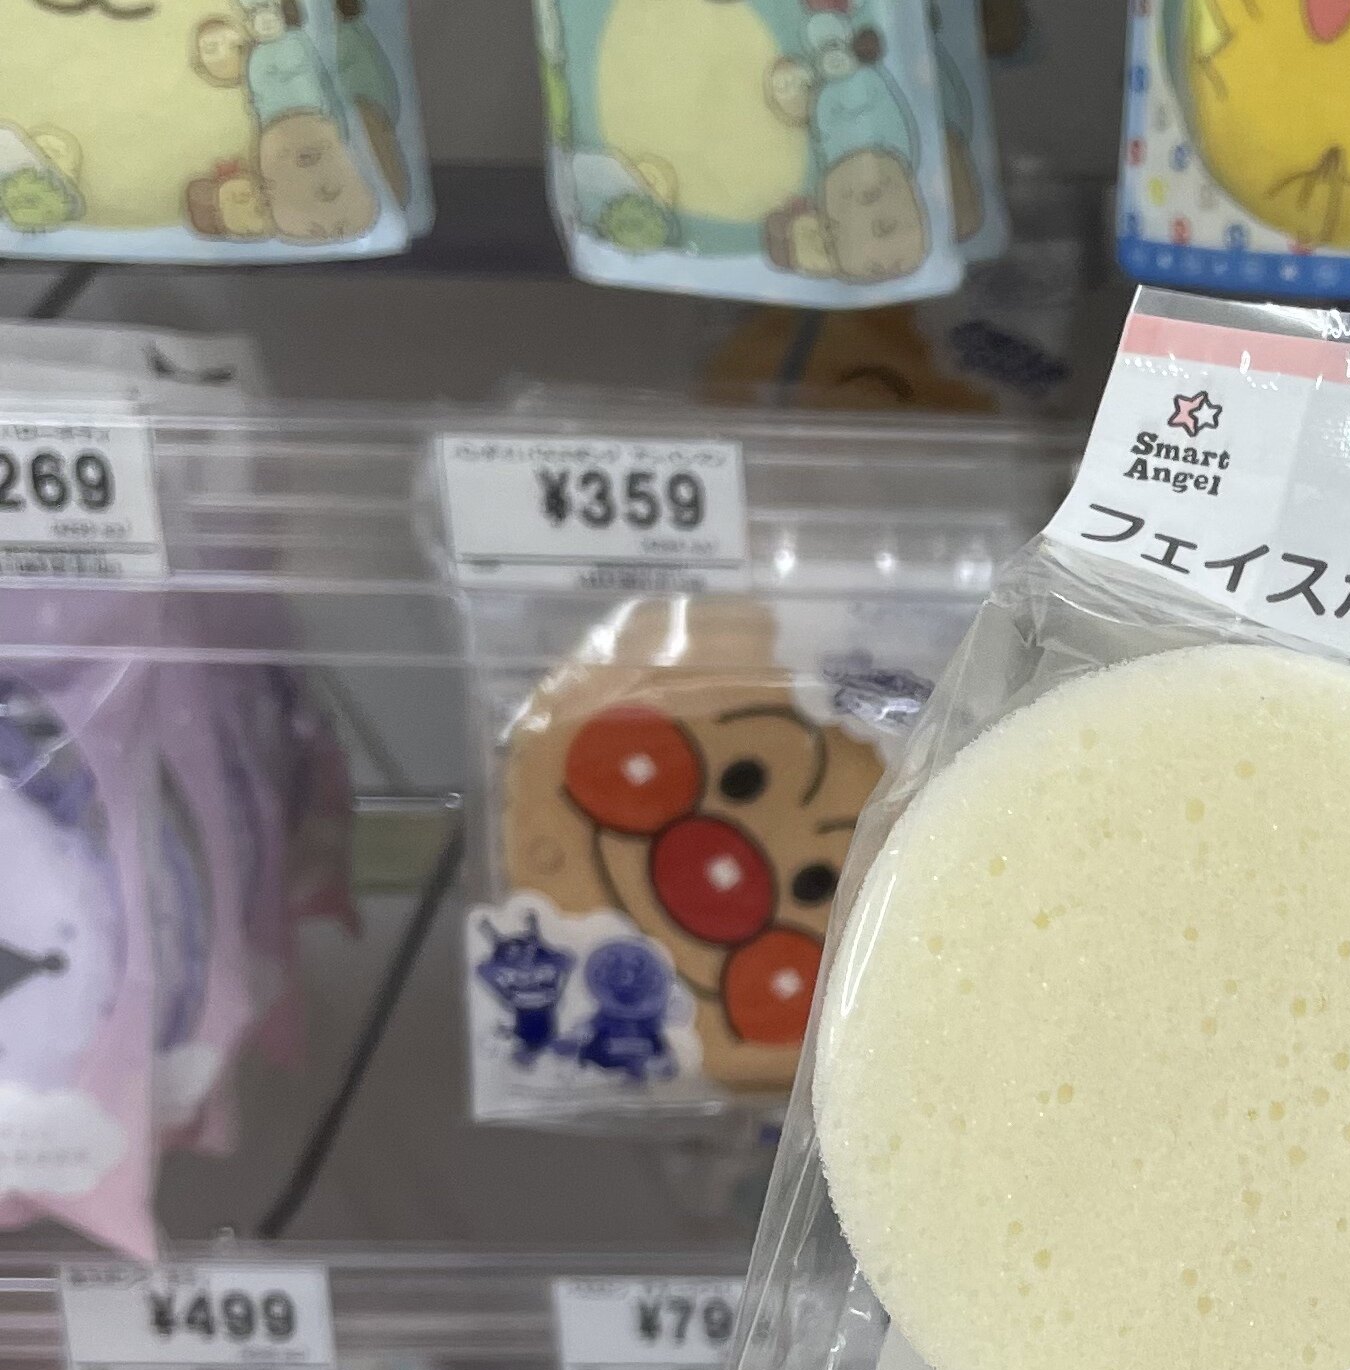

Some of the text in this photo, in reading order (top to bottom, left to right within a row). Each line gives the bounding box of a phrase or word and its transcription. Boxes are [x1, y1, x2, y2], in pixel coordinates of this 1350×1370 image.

[1131, 431, 1230, 470] Smart
[536, 466, 706, 530] ¥359
[1123, 457, 1221, 496] Angel
[148, 1289, 297, 1343] ¥499
[638, 1297, 736, 1345] ¥79
